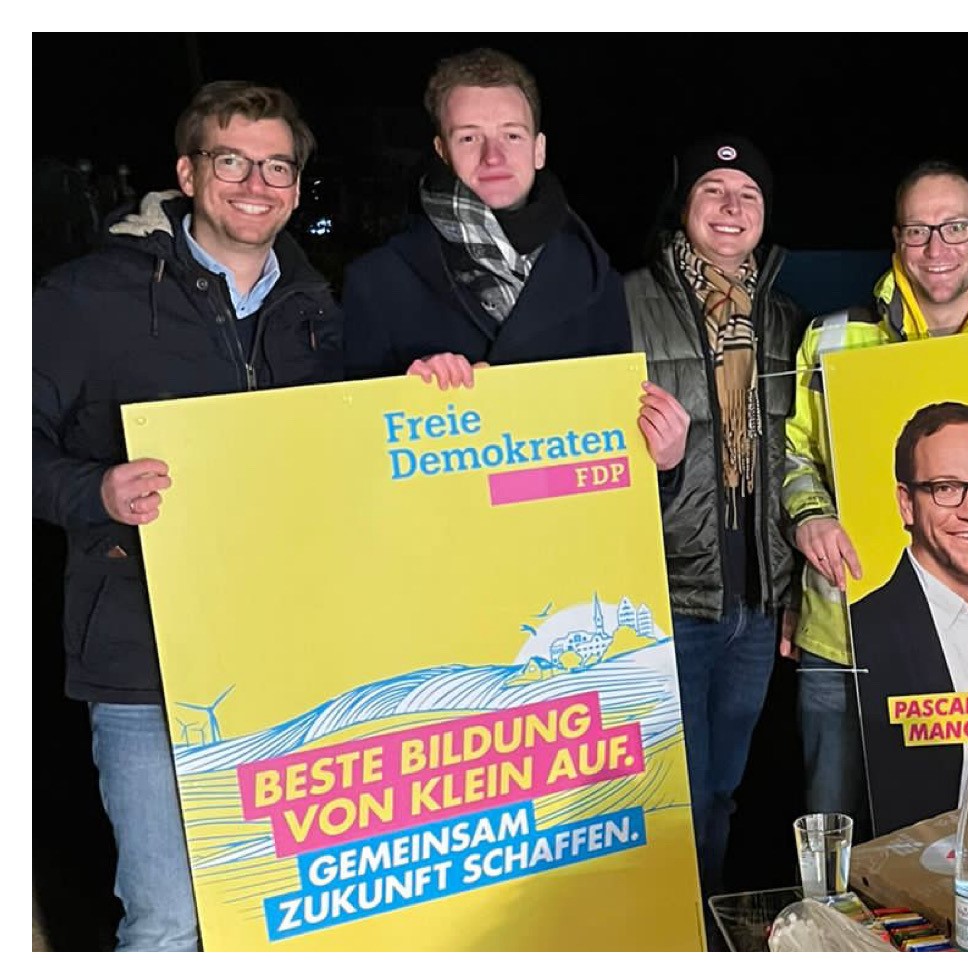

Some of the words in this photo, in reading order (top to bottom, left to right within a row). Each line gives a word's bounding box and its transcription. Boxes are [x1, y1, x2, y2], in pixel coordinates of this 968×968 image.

[384, 404, 481, 443] Freie
[388, 428, 627, 480] Demokraten
[575, 463, 626, 488] FDP
[254, 746, 384, 808] BESTE
[400, 702, 591, 775] BILDUNG
[283, 788, 394, 843] VON
[411, 755, 532, 816] KLEIN
[546, 734, 636, 784] AUF.
[276, 862, 453, 933] ZUKUNFT
[462, 815, 640, 884] SCHAFFEN.
[308, 808, 530, 888] GEMEINSAM
